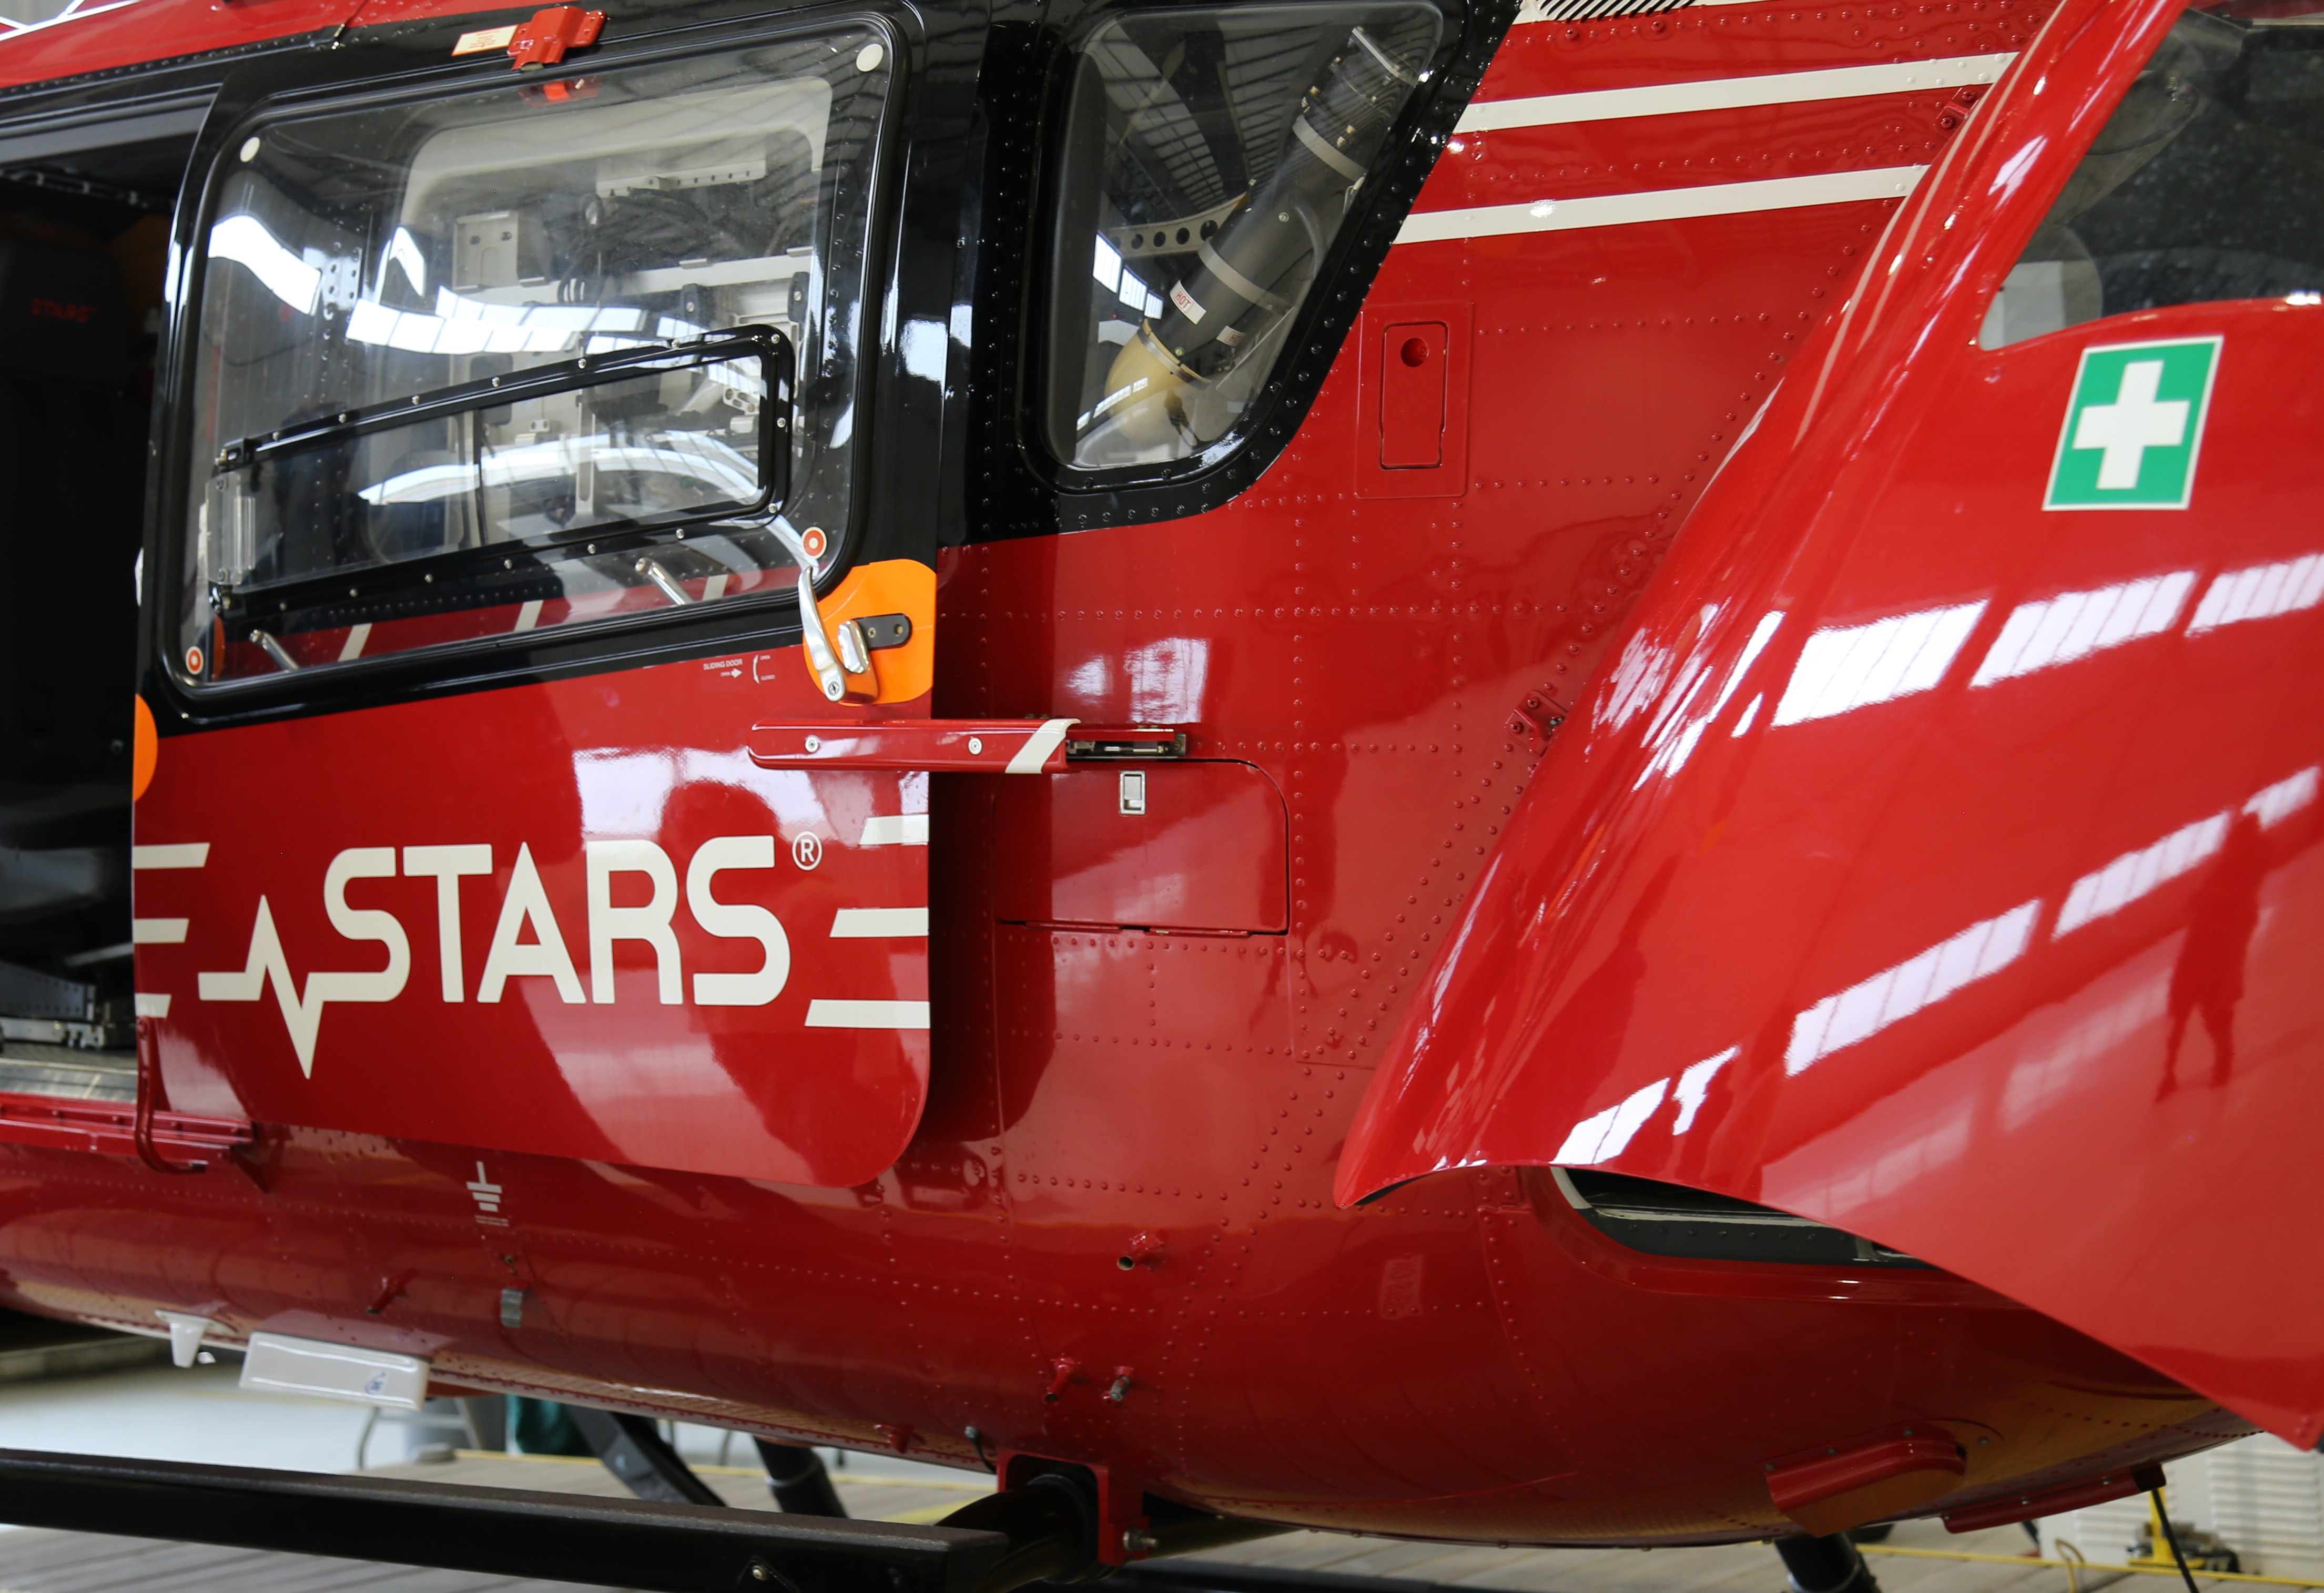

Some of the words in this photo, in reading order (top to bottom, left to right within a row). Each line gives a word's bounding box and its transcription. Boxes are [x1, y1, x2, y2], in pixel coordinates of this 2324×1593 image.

[1175, 290, 1192, 309] HOT
[30, 298, 89, 322] STARS
[703, 661, 725, 671] SLIDING
[726, 658, 743, 667] DOOR
